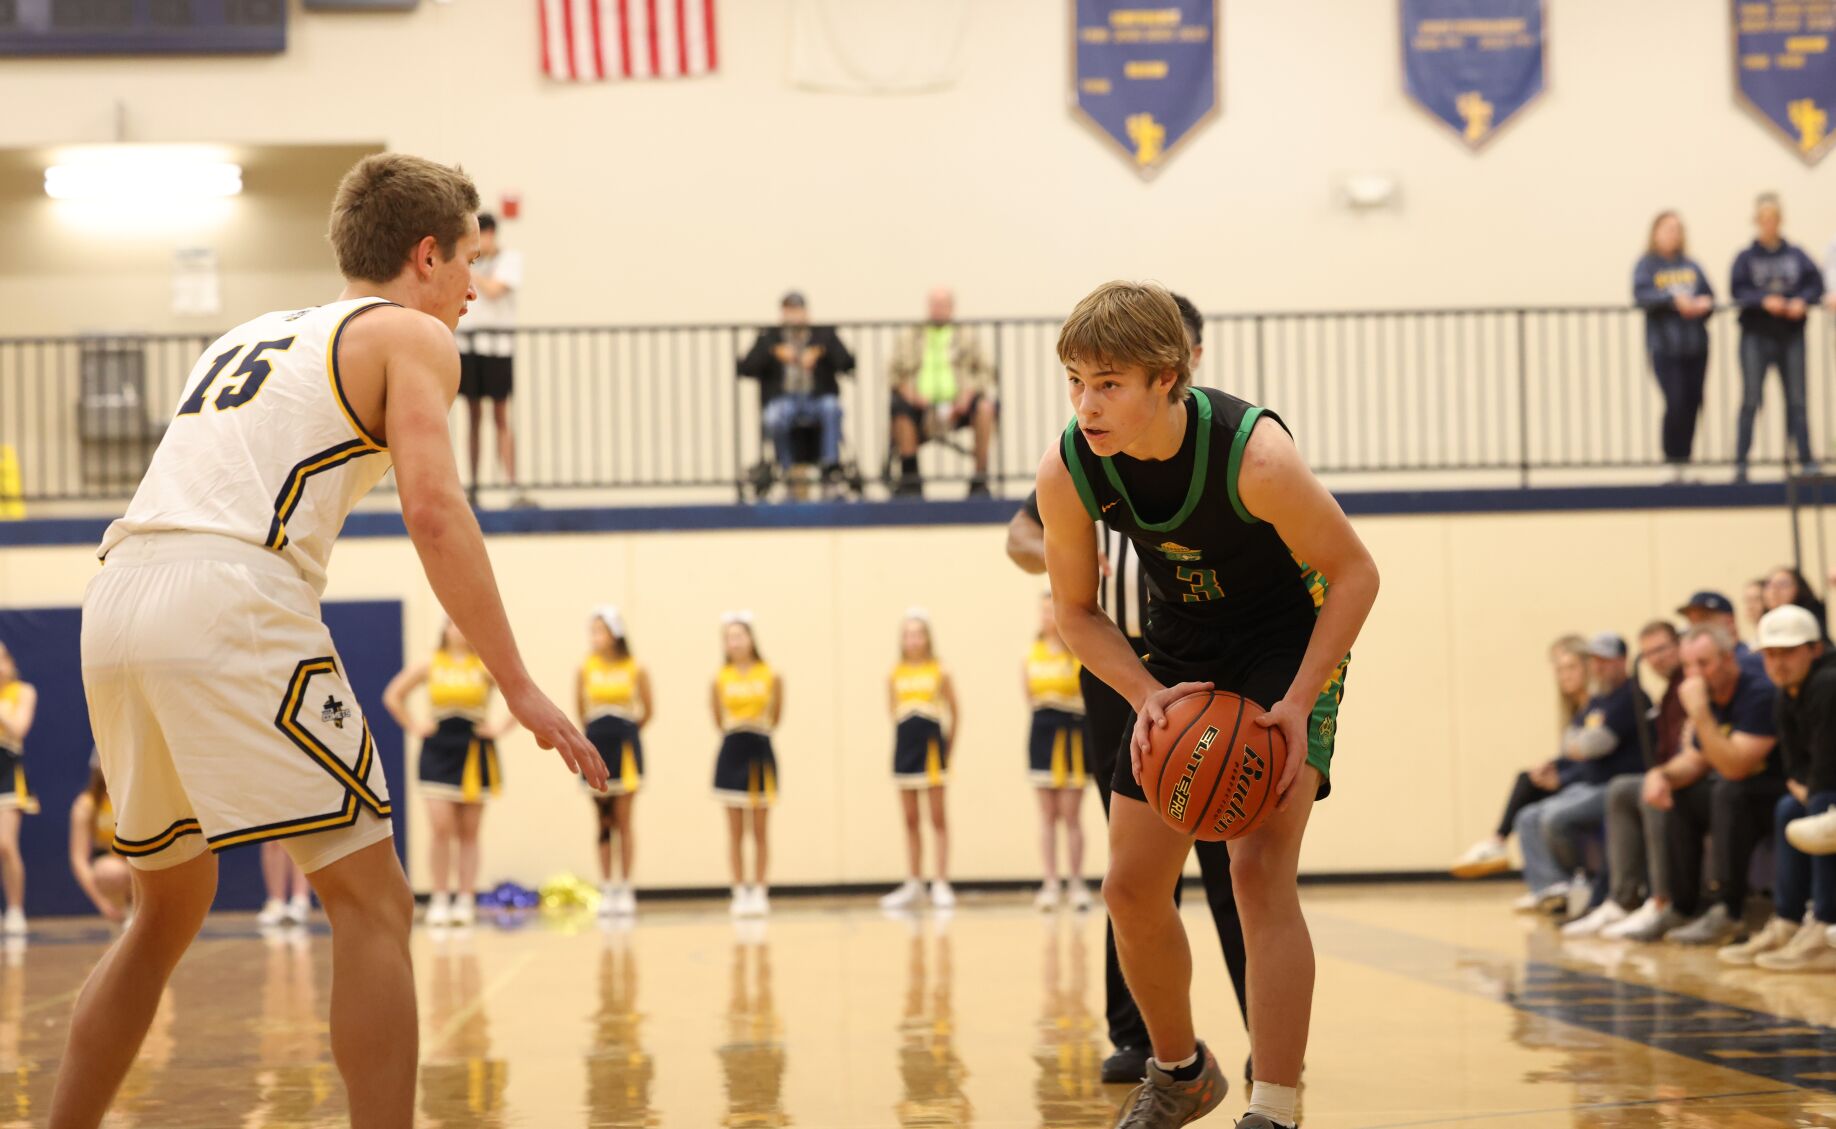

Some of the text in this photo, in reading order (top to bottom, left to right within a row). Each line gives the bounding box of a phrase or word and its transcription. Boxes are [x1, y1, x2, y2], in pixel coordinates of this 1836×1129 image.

[176, 335, 296, 417] 15
[1176, 565, 1225, 603] 3
[1213, 743, 1265, 834] Baden
